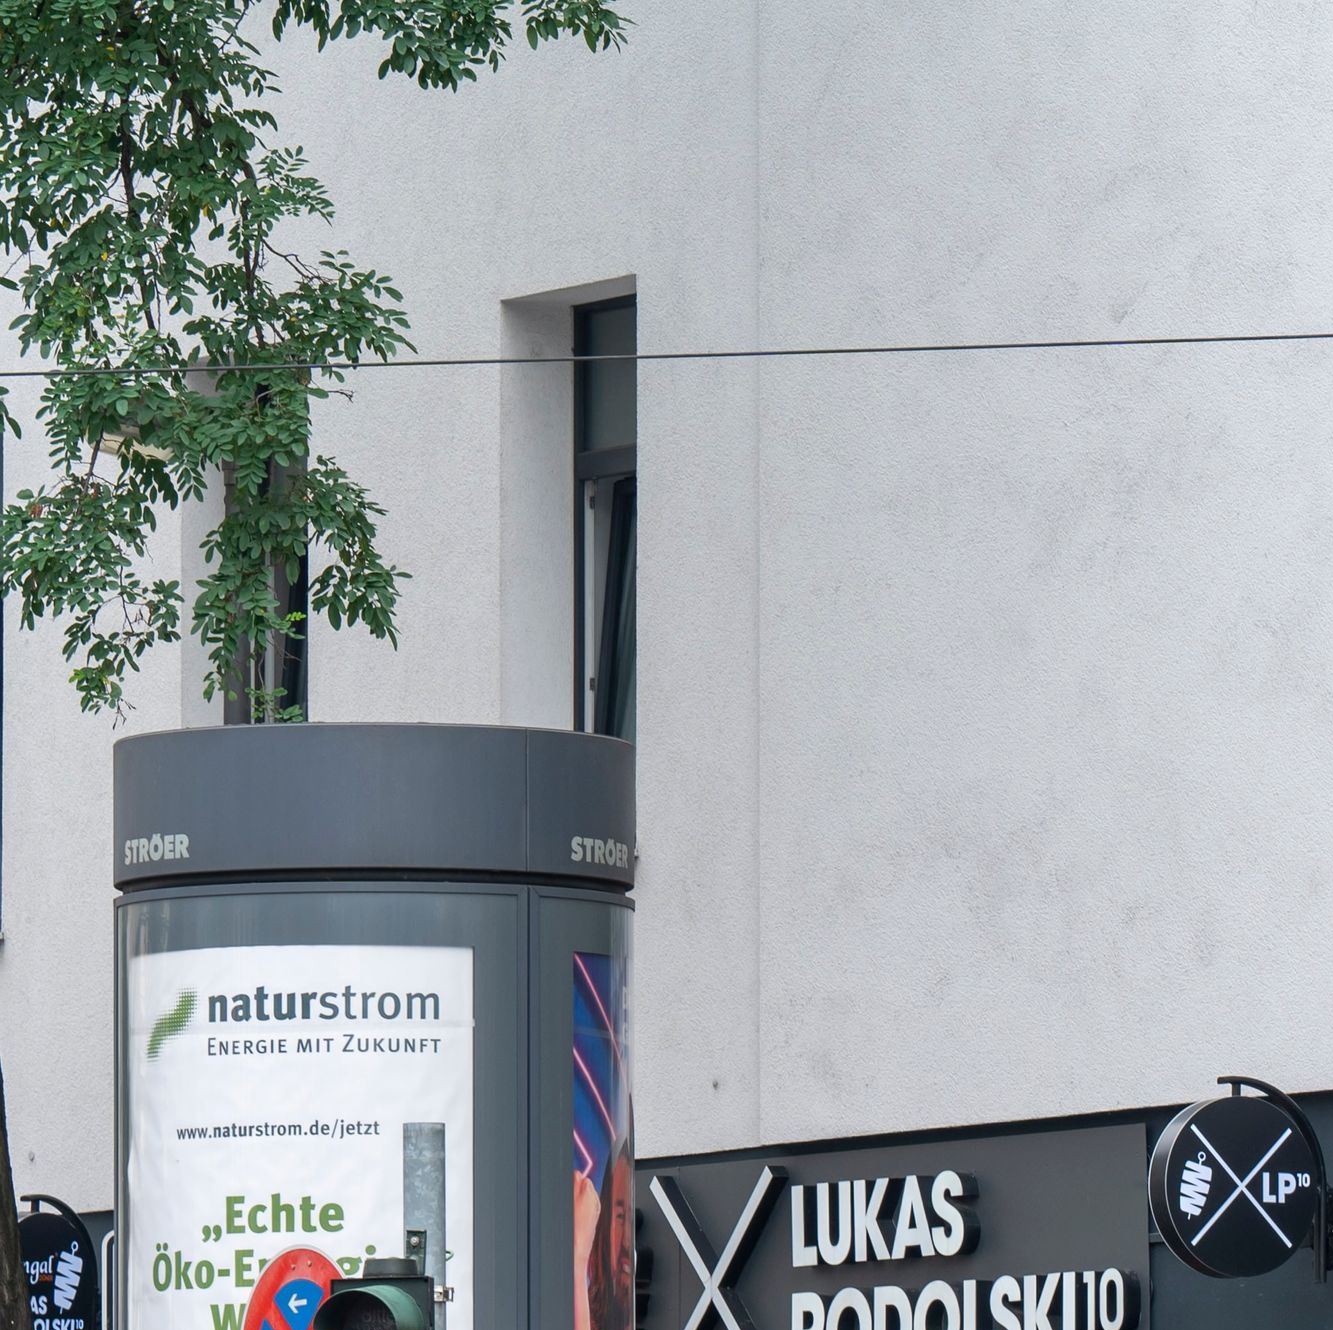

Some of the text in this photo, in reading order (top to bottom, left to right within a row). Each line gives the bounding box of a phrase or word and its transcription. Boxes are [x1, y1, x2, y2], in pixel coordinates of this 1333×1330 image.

[124, 833, 190, 865] STRÖER
[570, 836, 629, 869] STRÖER
[208, 985, 441, 1024] naturstrom
[342, 1032, 442, 1055] ZUKUNFT
[176, 1118, 380, 1140] www.naturstrom.de/jetzt
[791, 1170, 968, 1268] LUKAS
